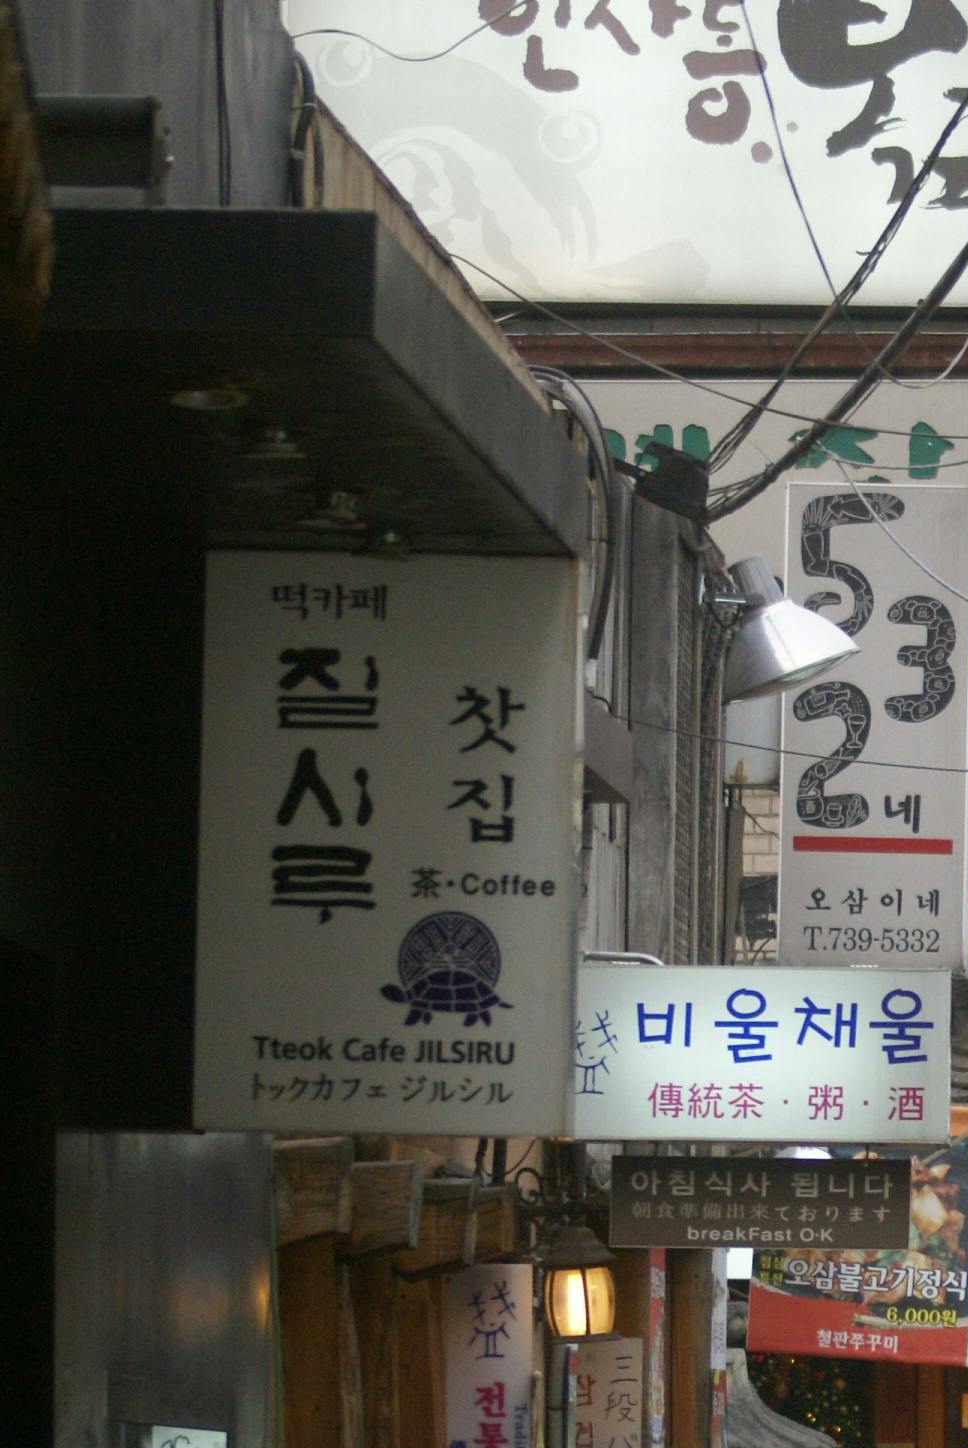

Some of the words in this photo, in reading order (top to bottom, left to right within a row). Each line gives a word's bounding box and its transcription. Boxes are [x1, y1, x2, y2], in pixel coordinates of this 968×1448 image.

[272, 583, 388, 620] 떡카페
[447, 685, 526, 844] 찻집
[805, 888, 940, 916] 오삼이네
[803, 926, 940, 953] T.739-5332
[636, 988, 935, 1065] 비울채울
[253, 1035, 333, 1062] Tteok
[343, 1038, 406, 1062] Cafe
[414, 1041, 515, 1065] JILSIRU
[631, 1170, 771, 1198] 아침식사
[791, 1172, 894, 1200] 됩니다
[687, 1226, 792, 1242] breakFast
[785, 1259, 968, 1301] 오삼불고기정식
